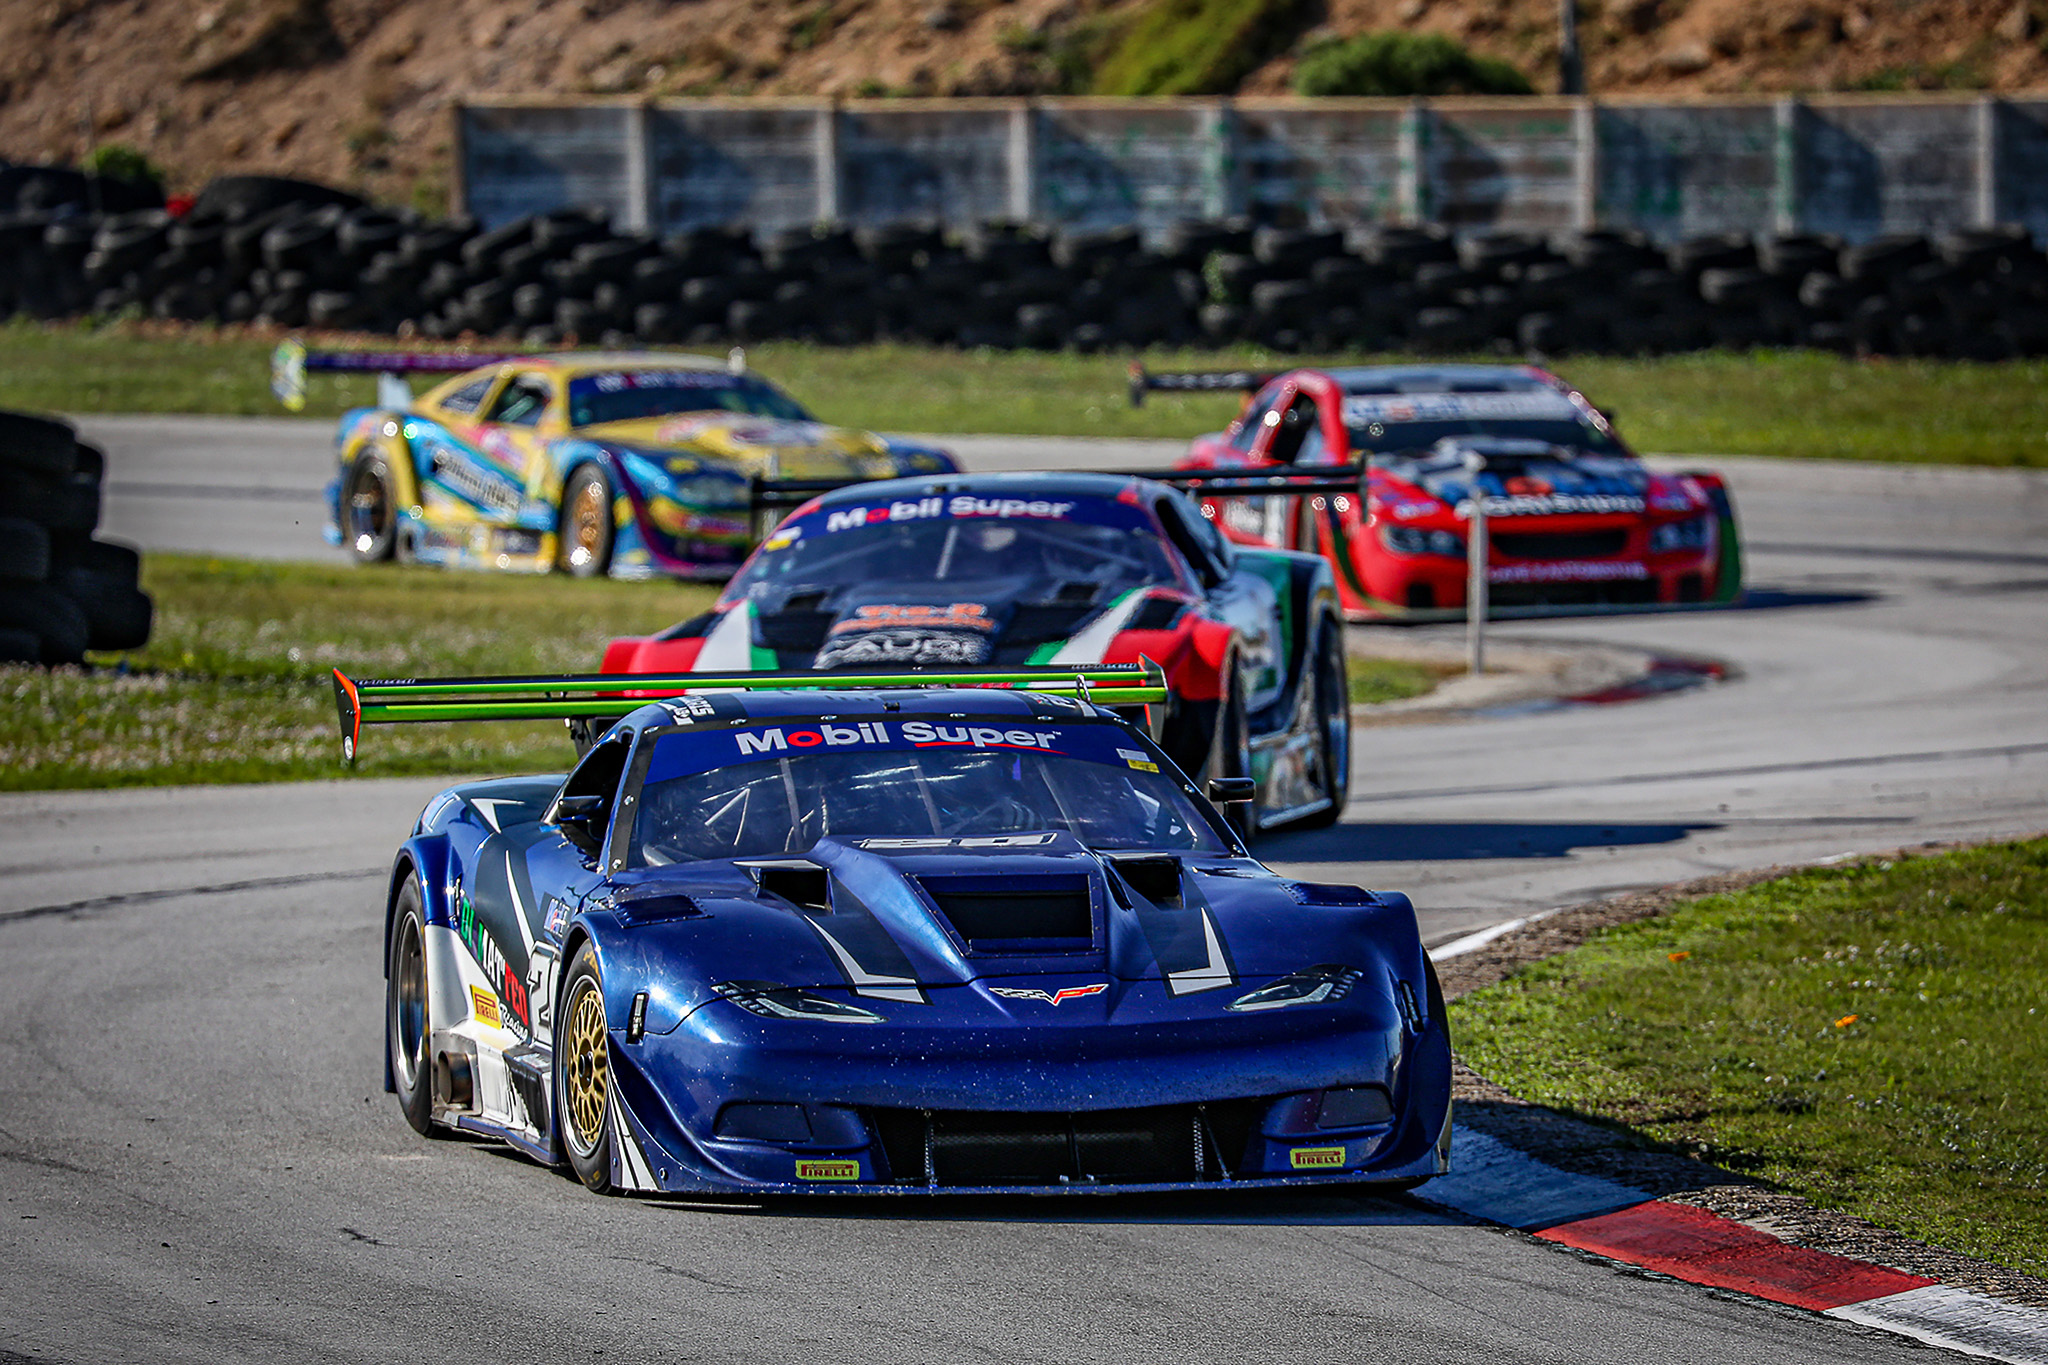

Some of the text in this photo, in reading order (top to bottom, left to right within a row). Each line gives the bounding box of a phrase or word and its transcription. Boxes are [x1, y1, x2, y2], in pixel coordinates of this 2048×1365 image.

[827, 496, 1071, 532] Mobil Super
[735, 721, 1056, 755] Mobil Super
[461, 896, 528, 1026] DI MATTEO
[475, 993, 498, 1022] PIRELLI
[801, 1164, 853, 1176] PIRELLI
[1295, 1151, 1341, 1164] PIRELLI
